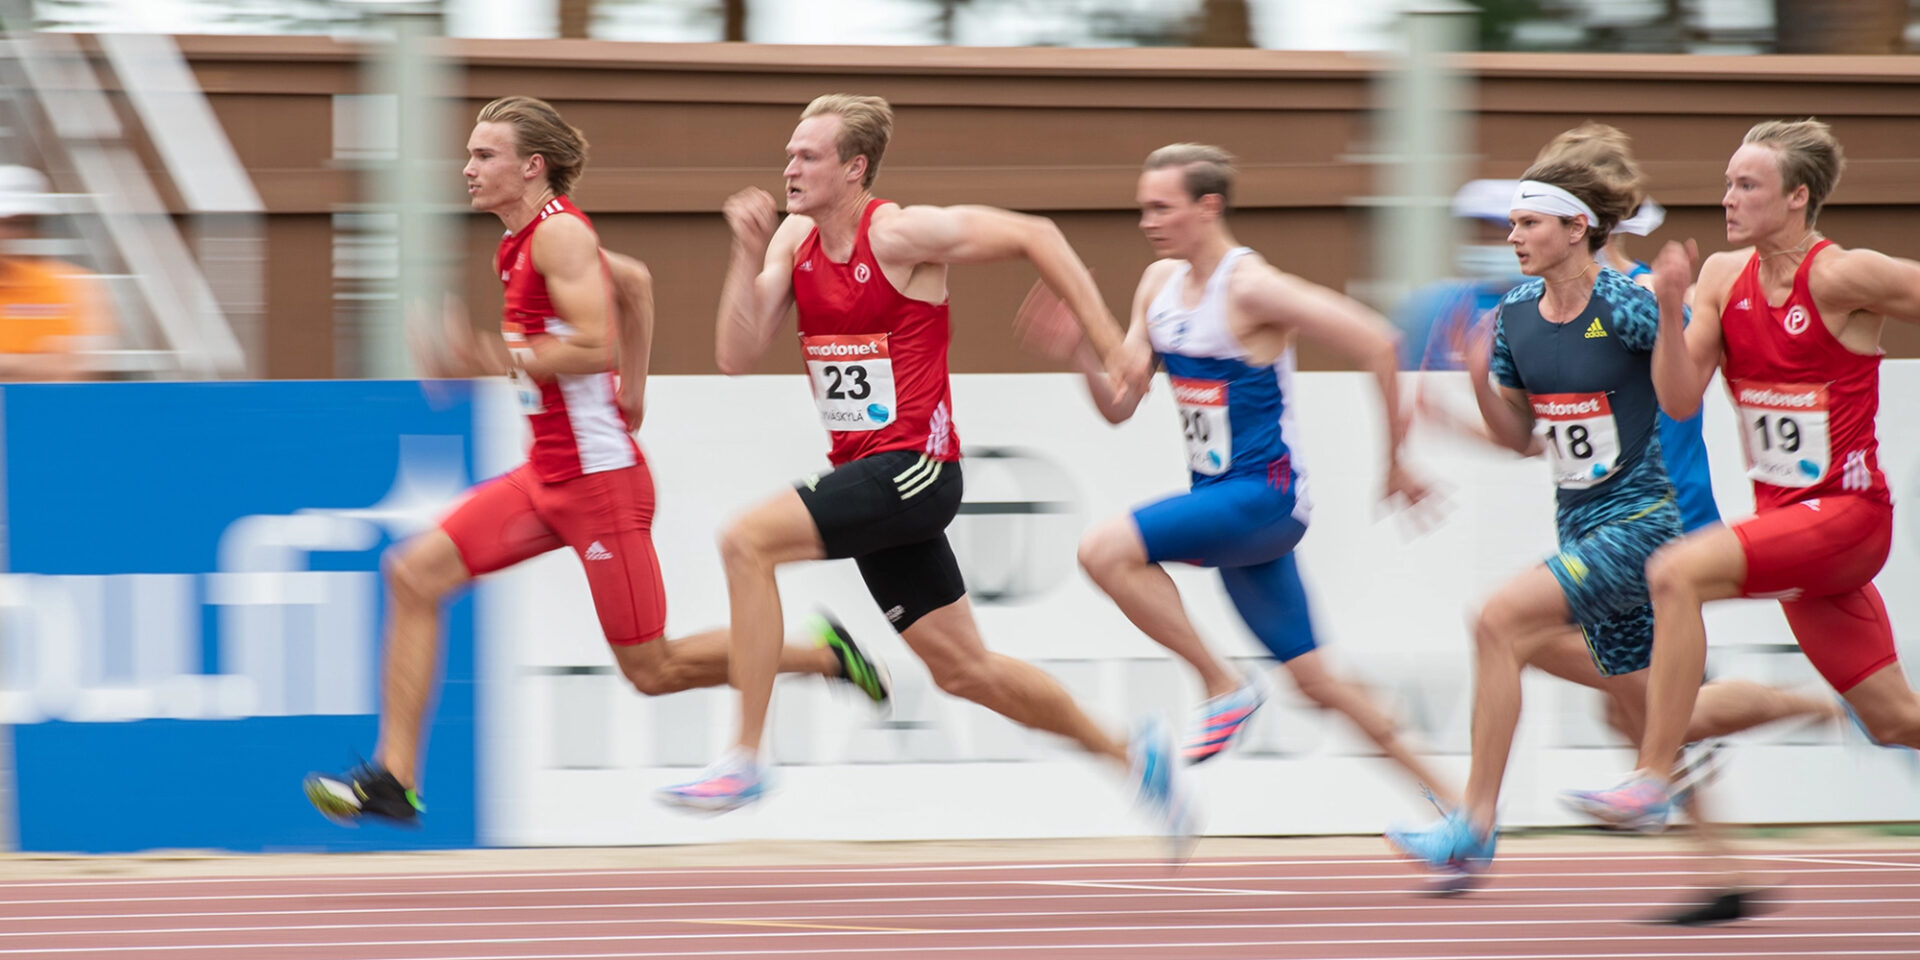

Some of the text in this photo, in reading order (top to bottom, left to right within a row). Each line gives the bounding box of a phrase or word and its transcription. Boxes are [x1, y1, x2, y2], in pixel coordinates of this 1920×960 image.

[806, 342, 879, 356] motonet
[823, 365, 872, 400] 23
[1740, 388, 1818, 408] motonet
[1533, 398, 1601, 416] motonet
[1180, 409, 1210, 443] 20
[1544, 424, 1594, 460] 18
[1753, 415, 1801, 453] 19
